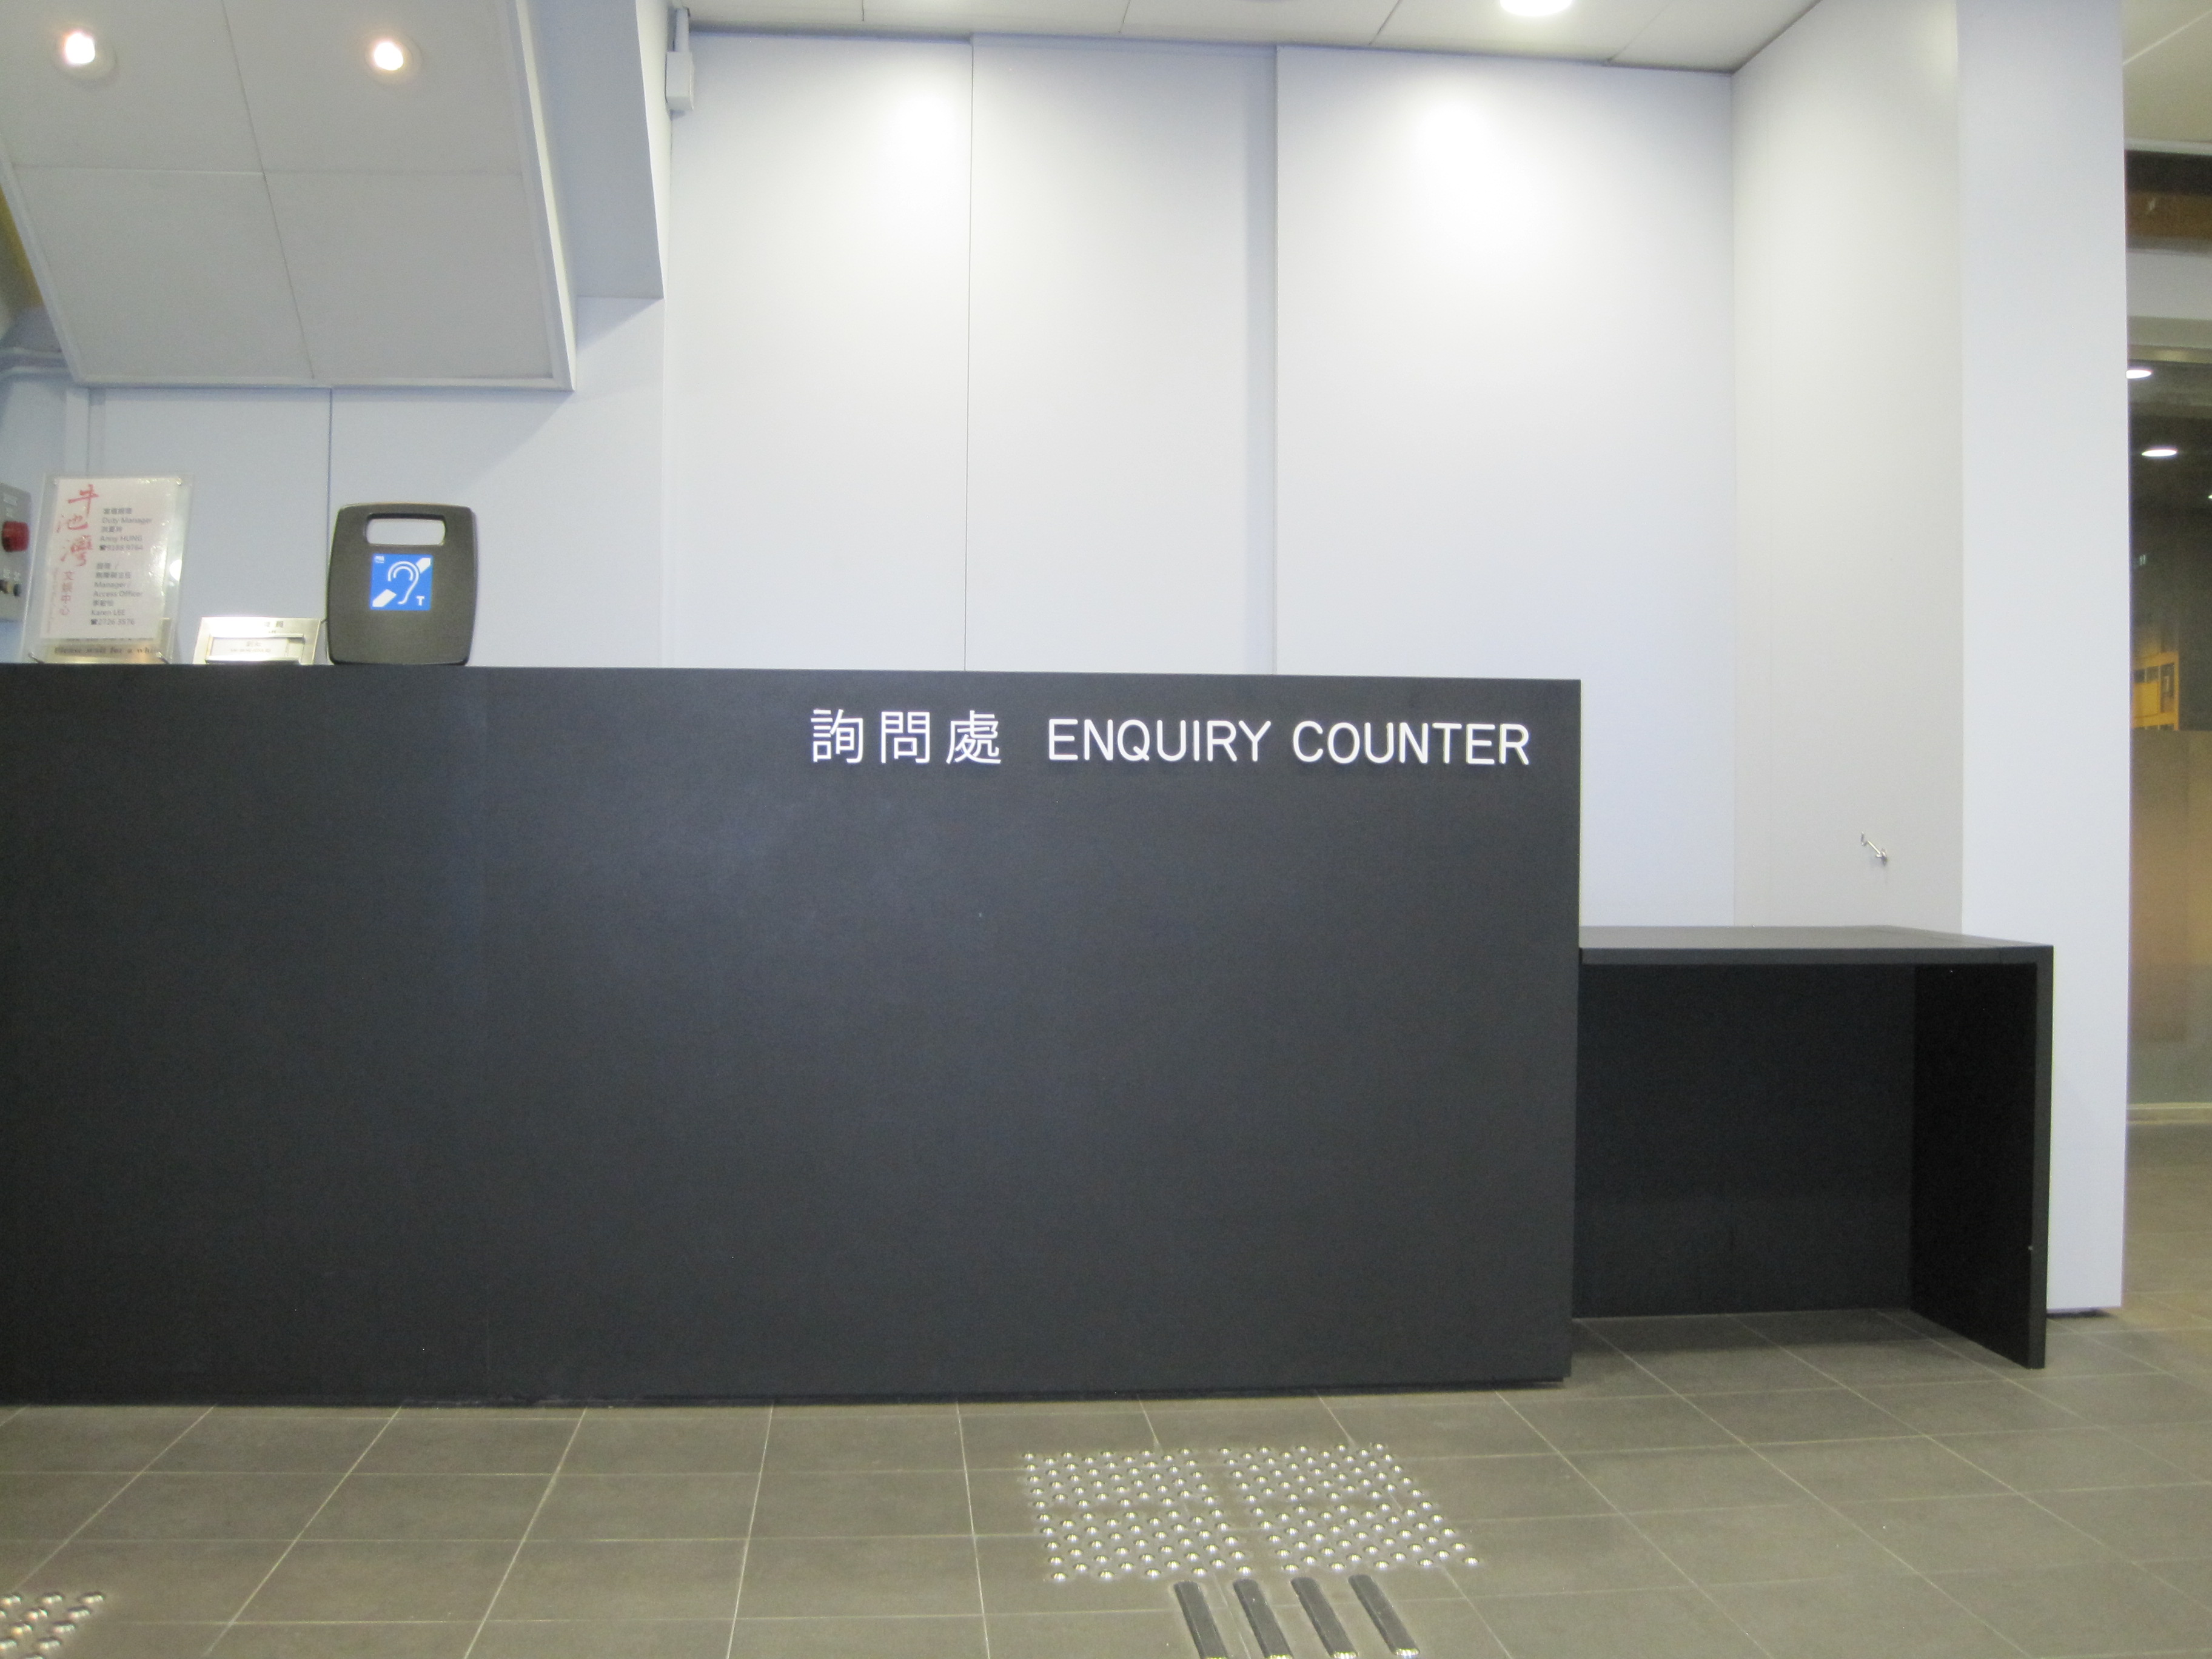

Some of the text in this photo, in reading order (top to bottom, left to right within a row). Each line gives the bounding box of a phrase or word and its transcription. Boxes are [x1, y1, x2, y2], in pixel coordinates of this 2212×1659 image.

[121, 517, 152, 525] Manager
[416, 595, 425, 606] T
[810, 708, 1002, 765] 詢問處
[1048, 718, 1530, 766] ENQUIRY COUNTER
